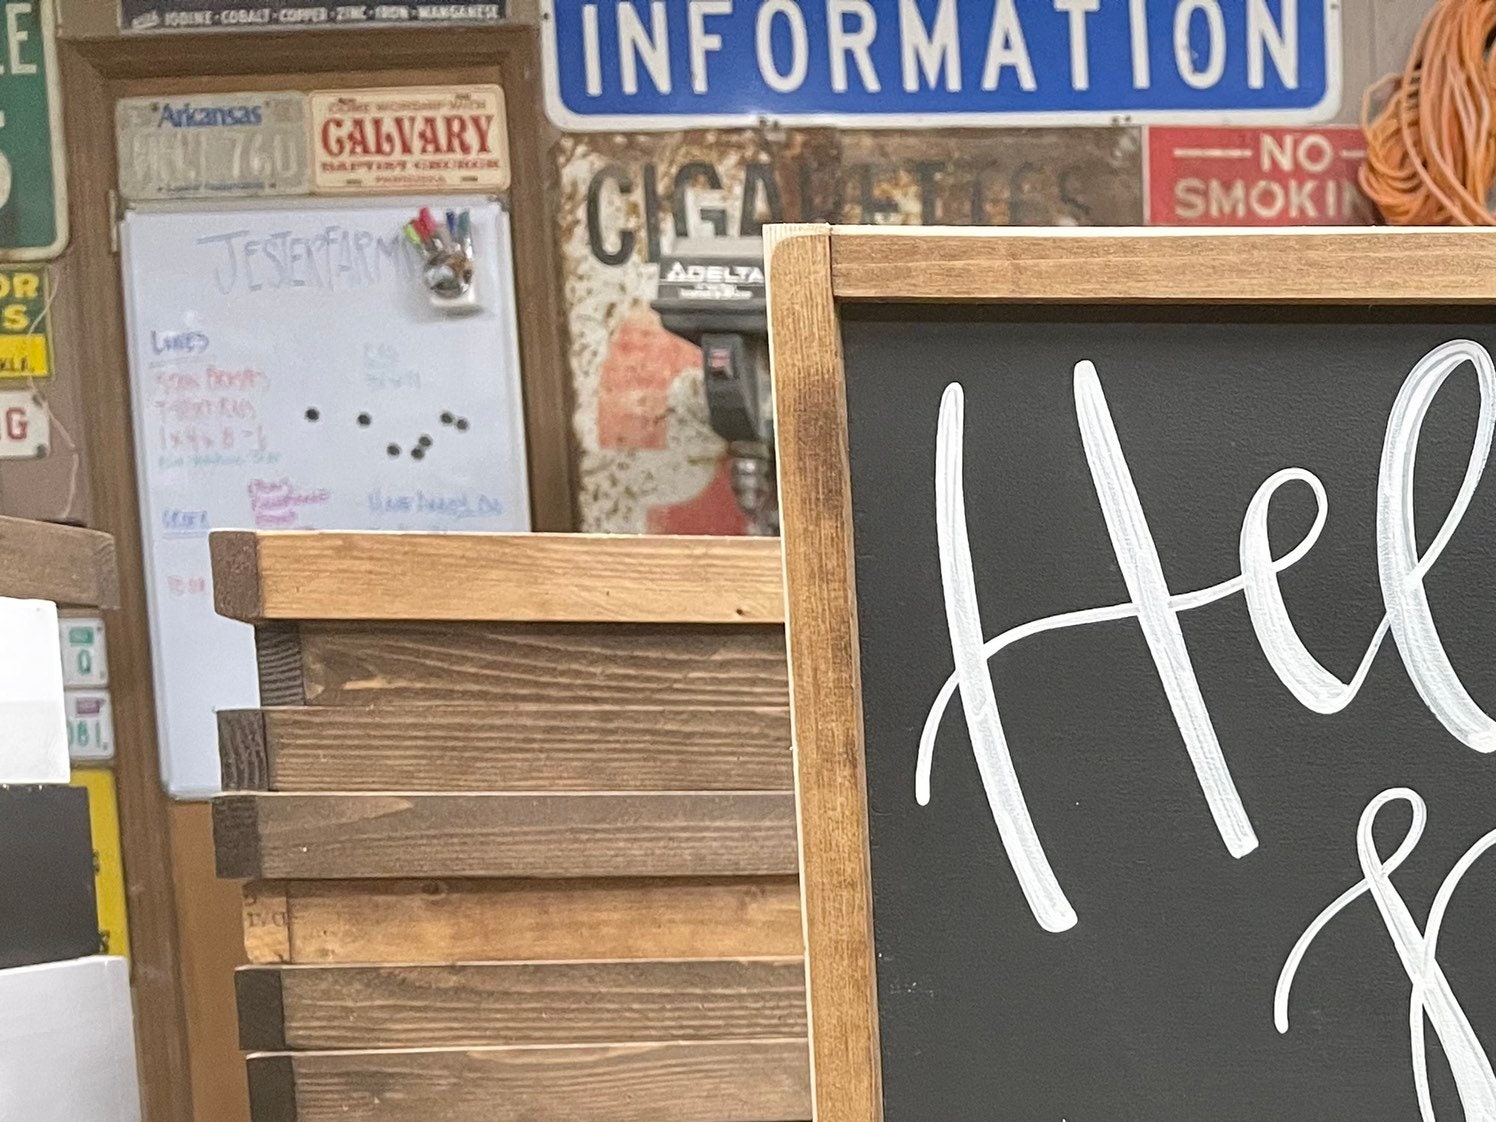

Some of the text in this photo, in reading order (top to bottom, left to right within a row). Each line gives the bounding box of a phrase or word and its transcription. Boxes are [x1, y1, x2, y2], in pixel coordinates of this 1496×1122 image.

[164, 10, 213, 27] IODINE
[221, 8, 271, 25] COBALT
[278, 6, 329, 23] COPPER
[336, 5, 368, 21] ZINC
[416, 3, 499, 19] MANGANESE
[583, 0, 1299, 97] INFORMATION
[157, 101, 263, 128] Arkansas
[321, 114, 495, 158] CALVARY
[1259, 132, 1334, 173] NO
[320, 158, 499, 172] BAPTIST CHURCH
